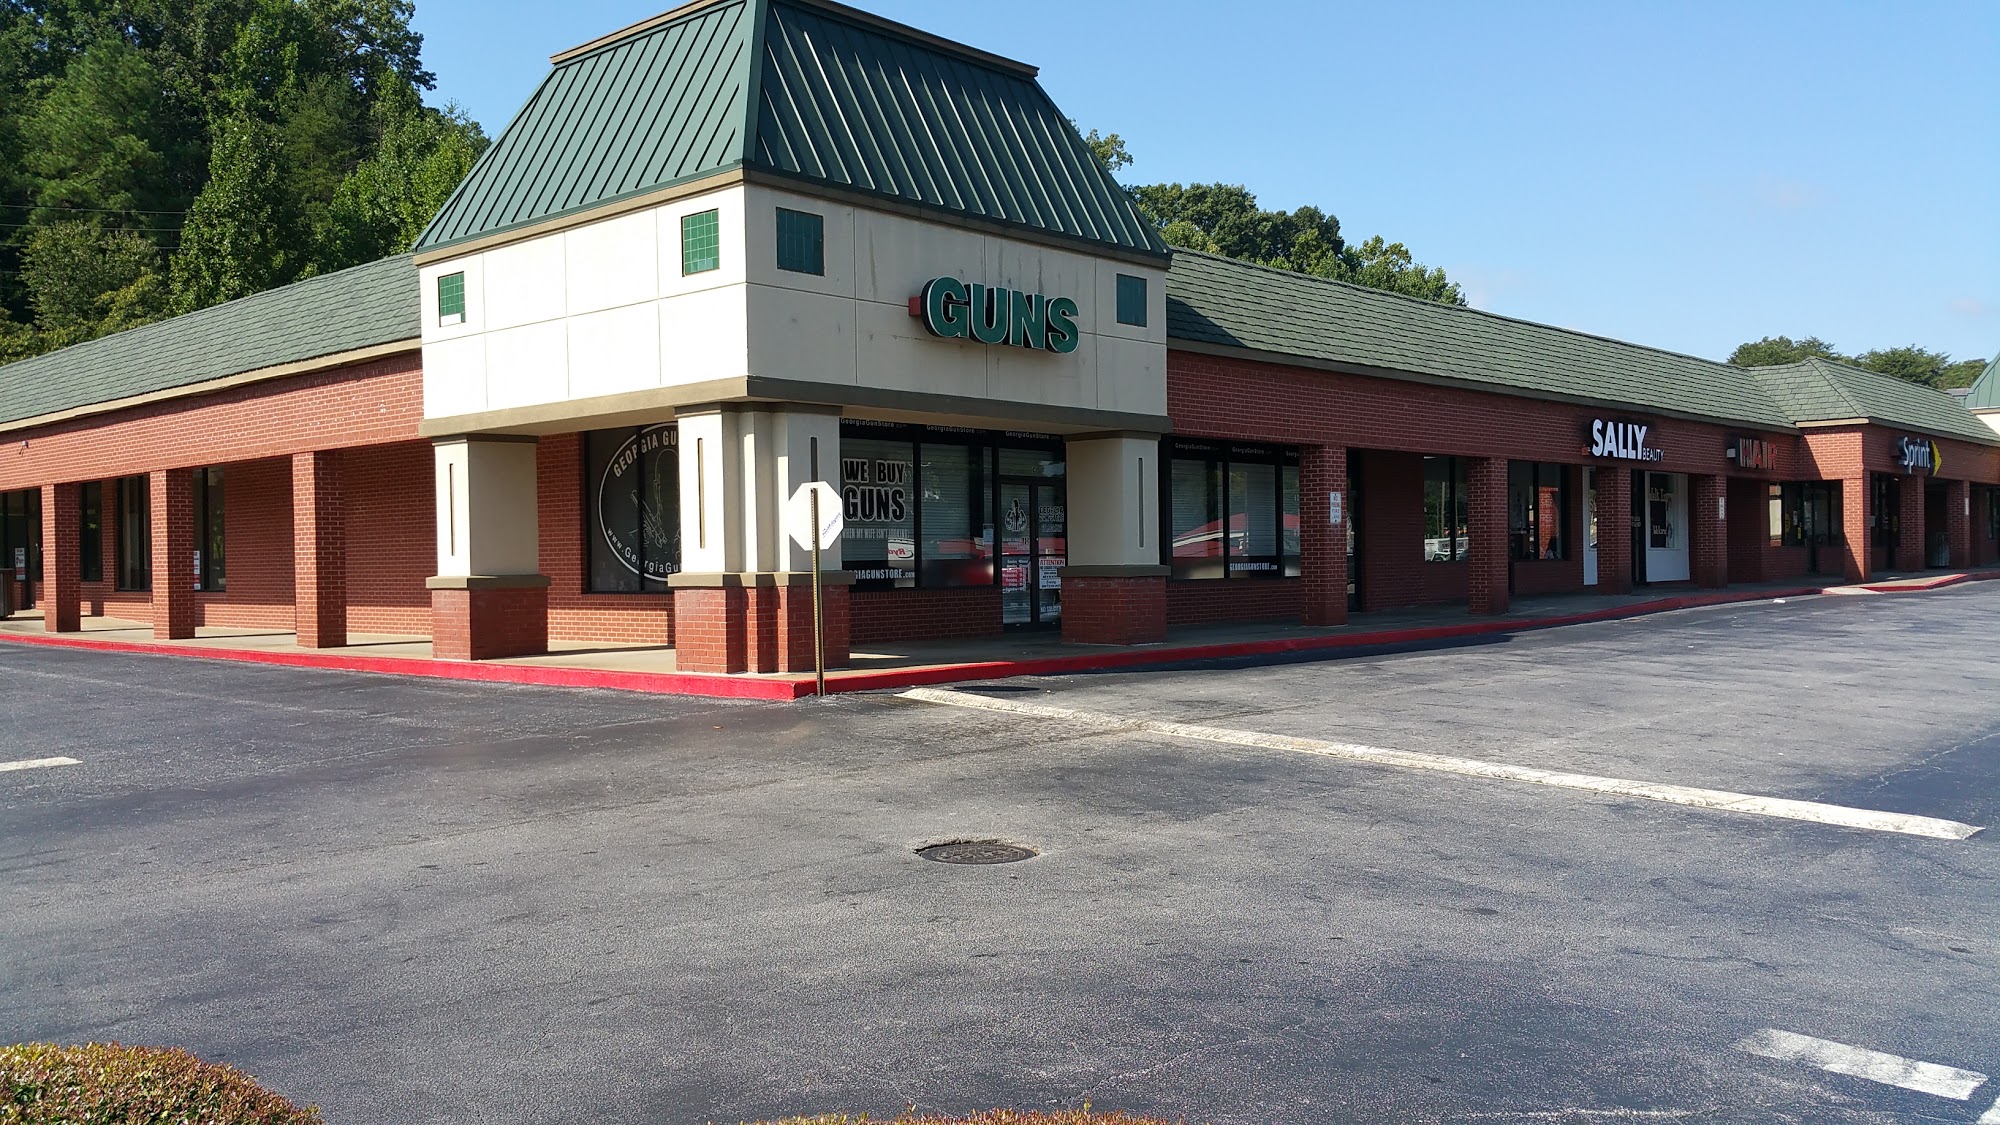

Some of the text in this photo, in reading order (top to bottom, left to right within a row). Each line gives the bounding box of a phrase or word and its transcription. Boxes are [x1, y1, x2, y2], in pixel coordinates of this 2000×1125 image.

[922, 277, 1080, 353] GUNS
[662, 430, 678, 446] GU
[1592, 419, 1665, 461] SALLY BEAUTY
[1739, 437, 1777, 470] HAIR
[1903, 436, 1930, 474] Sprint
[842, 458, 905, 484] WE BUY
[843, 485, 905, 521] GUNS
[864, 528, 876, 538] WIFE
